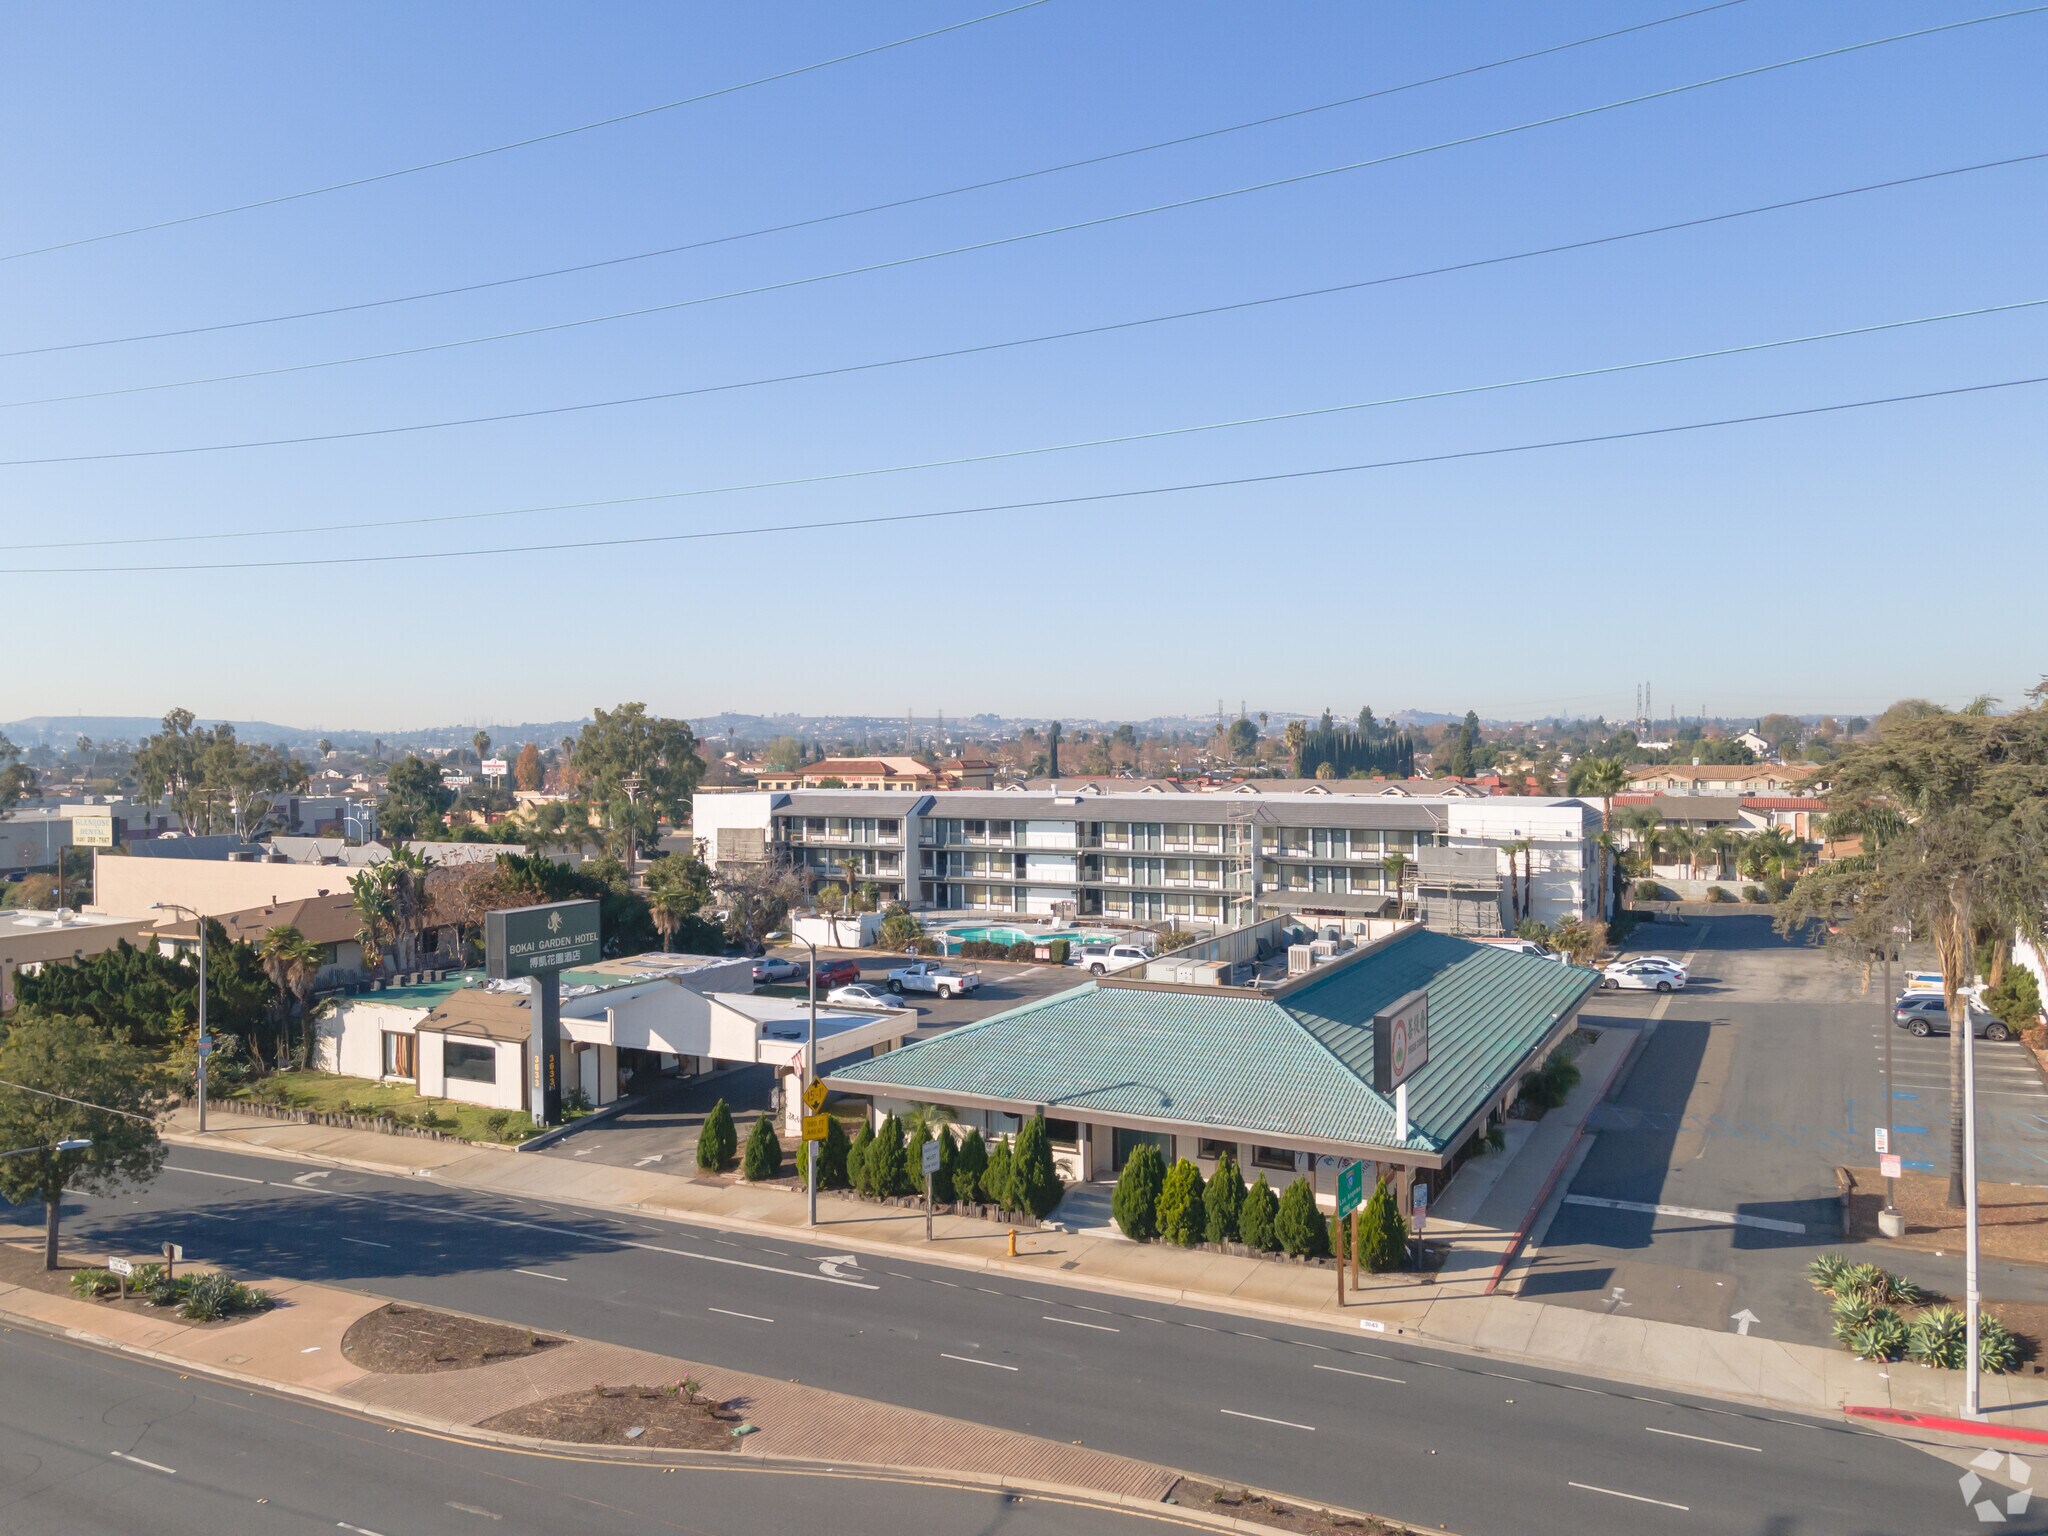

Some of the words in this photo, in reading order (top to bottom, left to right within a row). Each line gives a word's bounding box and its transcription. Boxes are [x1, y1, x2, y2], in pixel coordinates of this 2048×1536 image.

[75, 818, 110, 826] GLENROSE
[509, 942, 535, 954] BOKAI
[538, 936, 571, 949] GARDEN
[574, 932, 599, 943] HOTEL
[806, 1127, 824, 1135] AHEAD
